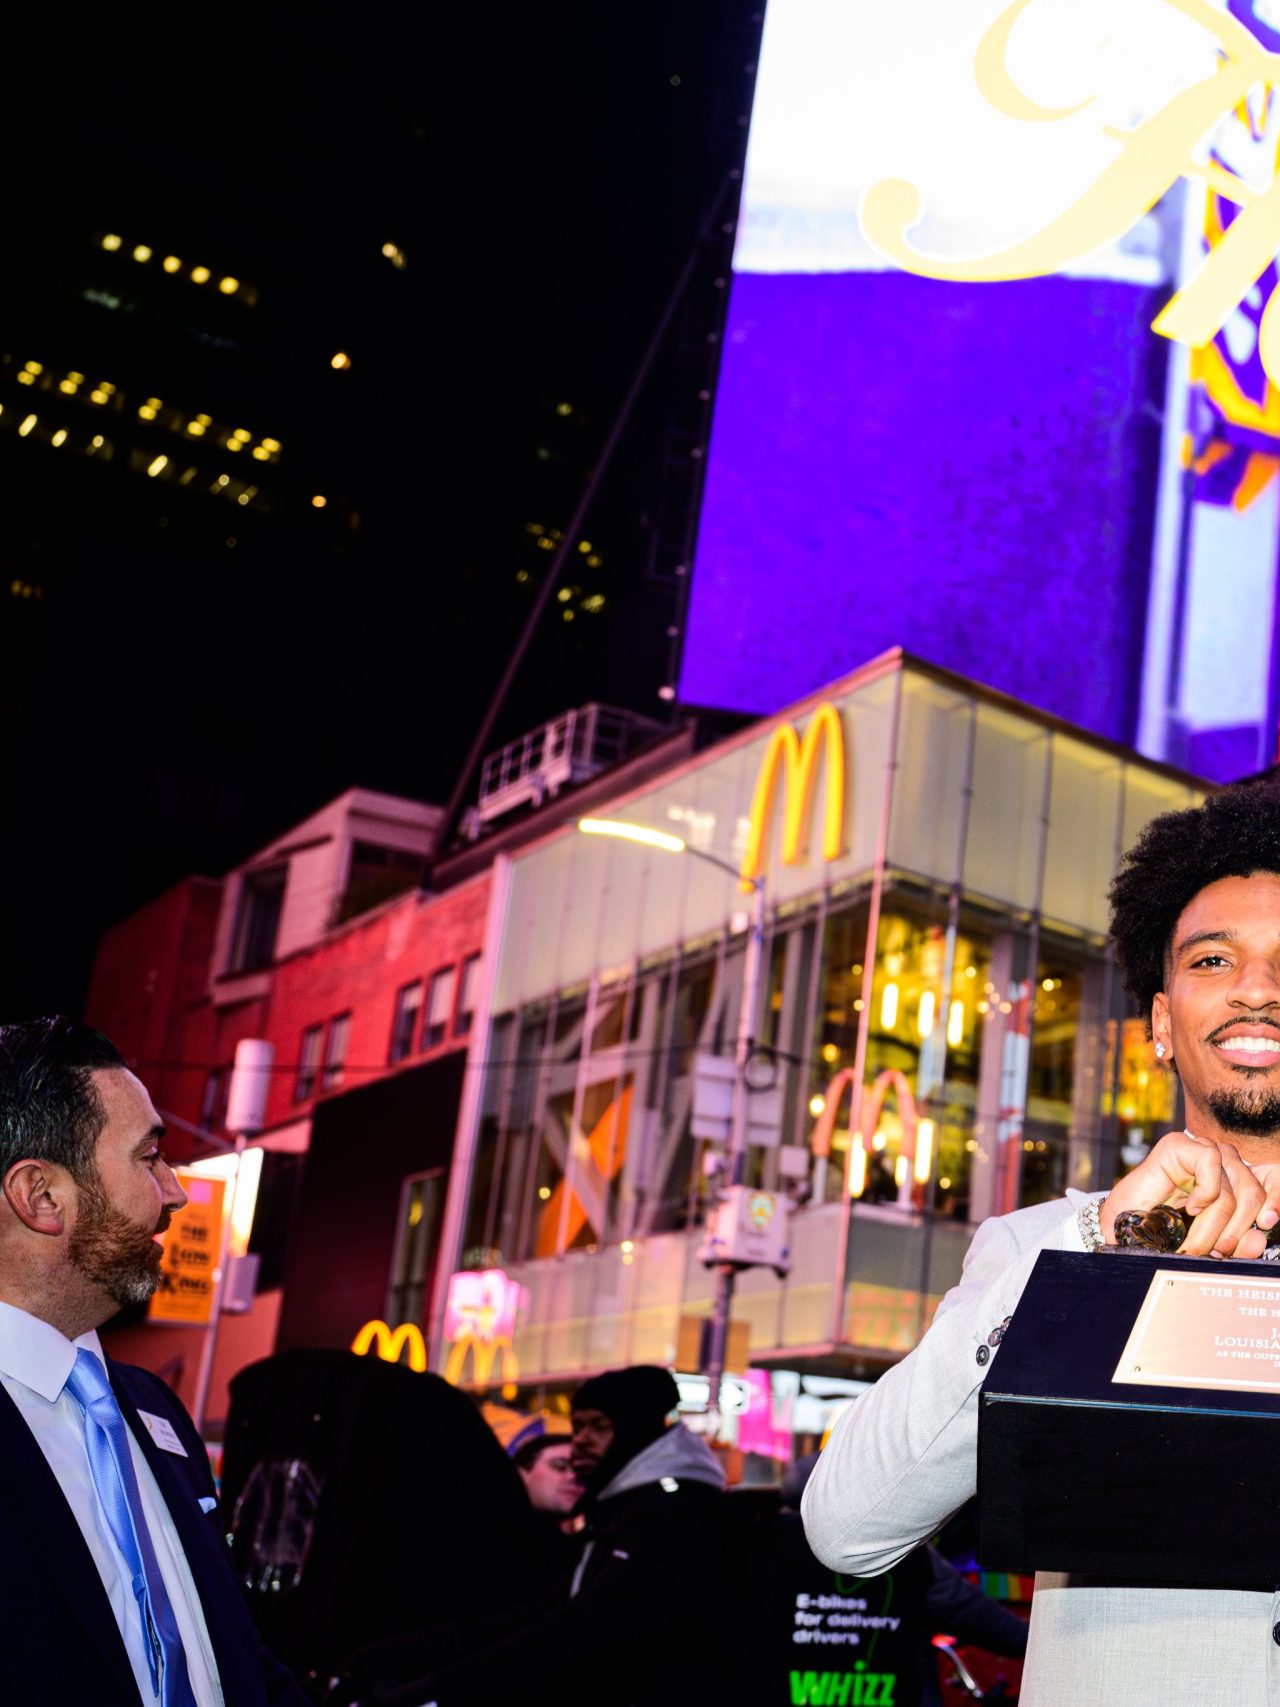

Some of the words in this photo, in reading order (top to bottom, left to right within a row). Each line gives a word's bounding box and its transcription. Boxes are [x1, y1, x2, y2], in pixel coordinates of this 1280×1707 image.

[1200, 1286, 1232, 1298] THE
[1238, 1307, 1267, 1316] THE
[1231, 1351, 1251, 1359] THE
[795, 1593, 868, 1610] E-bikes
[794, 1610, 824, 1627] for
[827, 1613, 900, 1632] delivery
[792, 1628, 860, 1645] drivers
